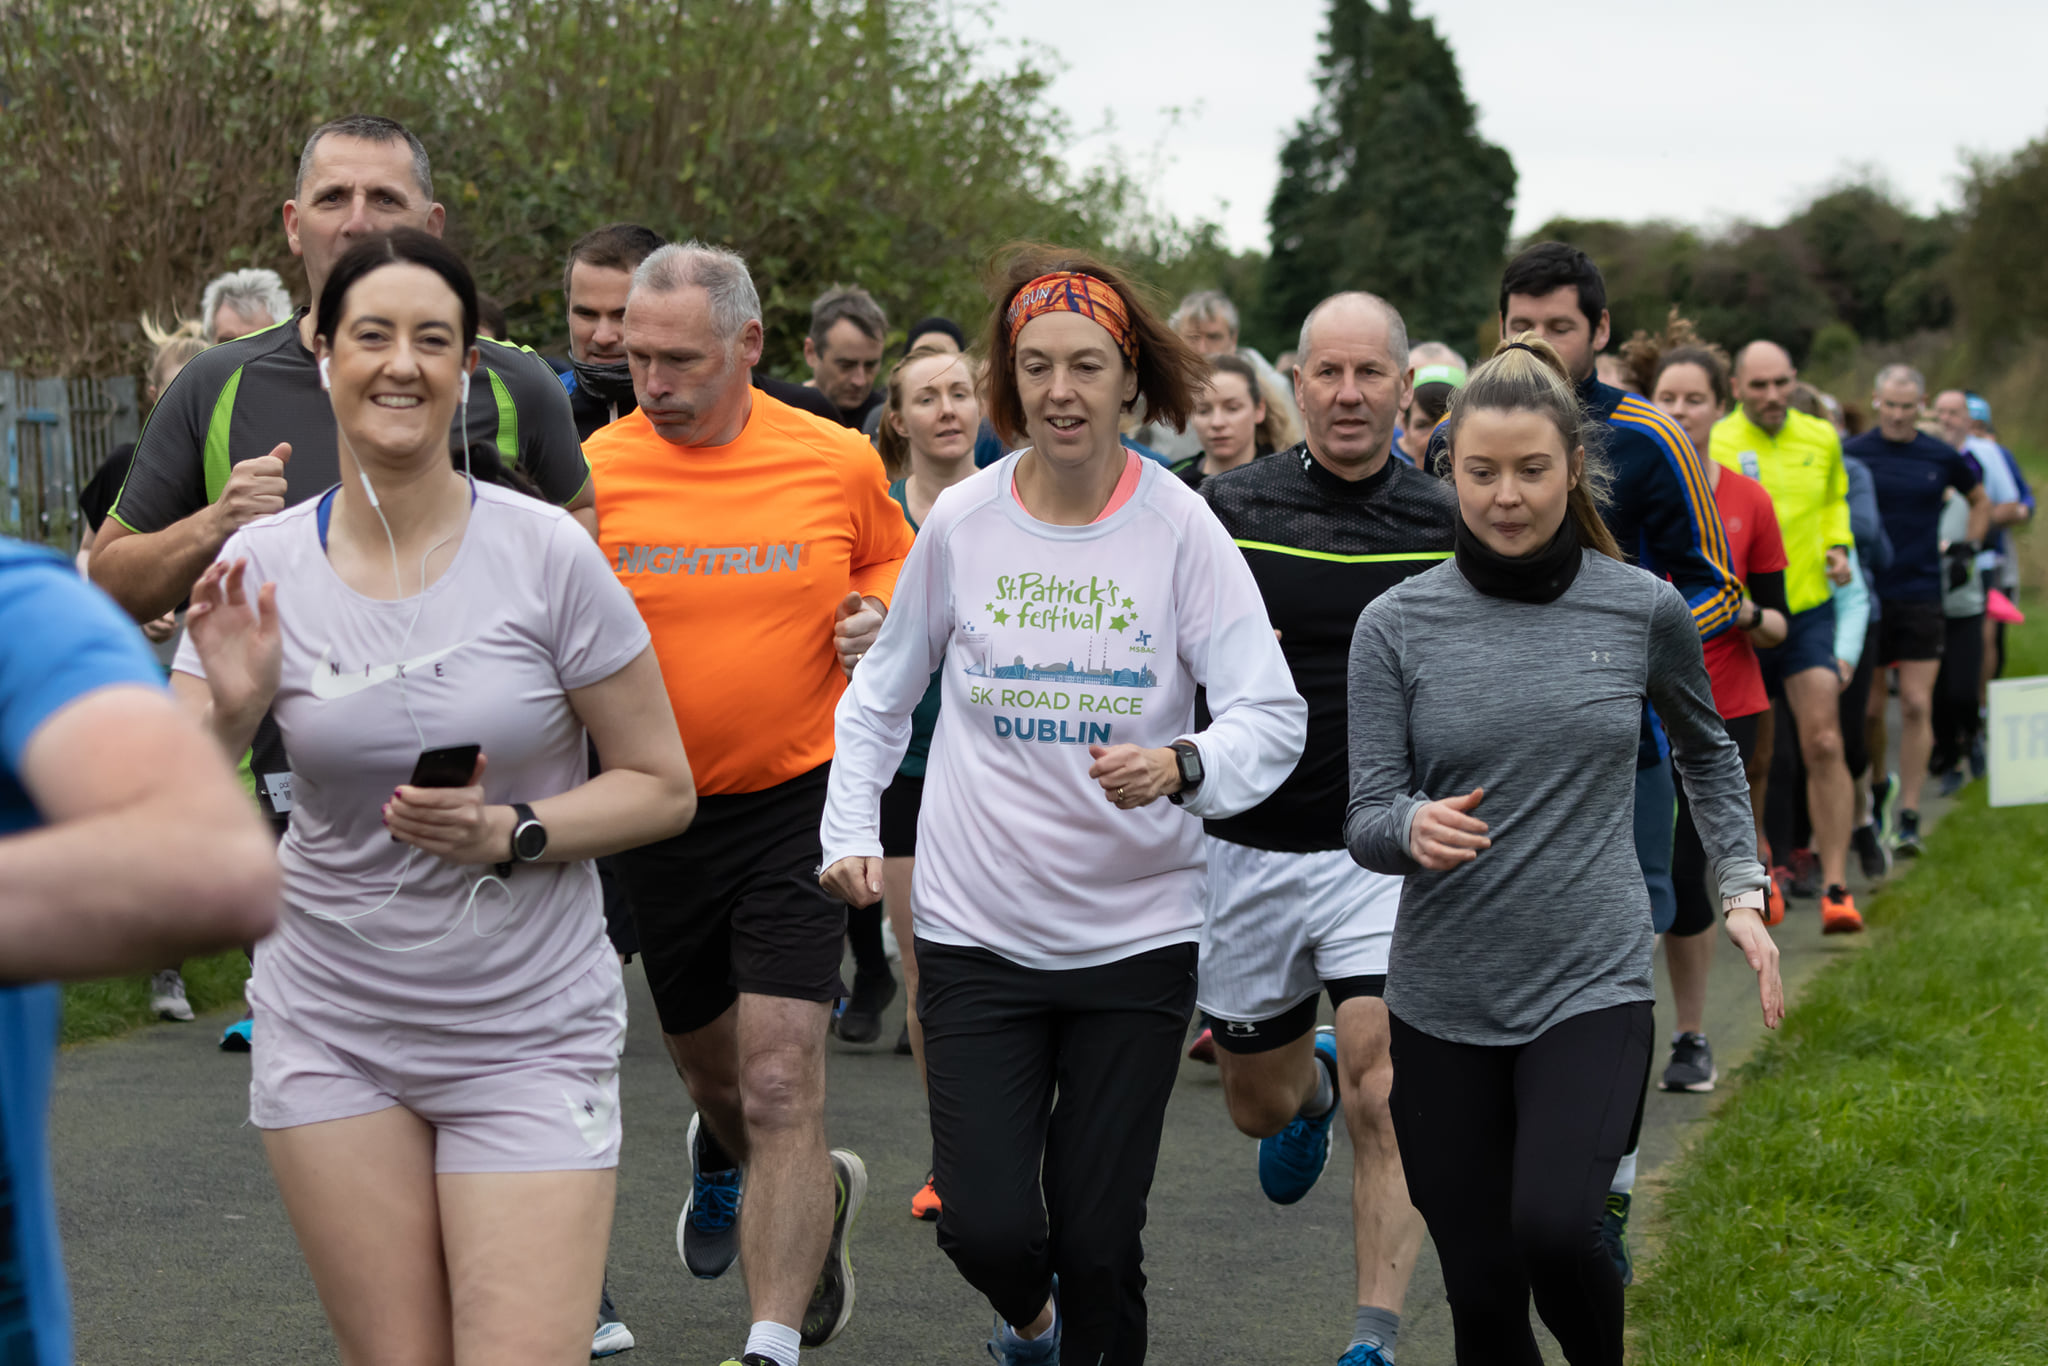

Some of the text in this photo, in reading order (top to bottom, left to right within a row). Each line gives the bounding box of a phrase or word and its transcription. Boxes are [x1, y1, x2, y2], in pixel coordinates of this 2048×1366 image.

[1022, 287, 1050, 309] RUN
[613, 543, 805, 575] NIGHTRUN
[330, 662, 444, 679] NIKE
[970, 685, 1144, 715] 5K ROAD RACE
[994, 715, 1112, 745] DUBLIN
